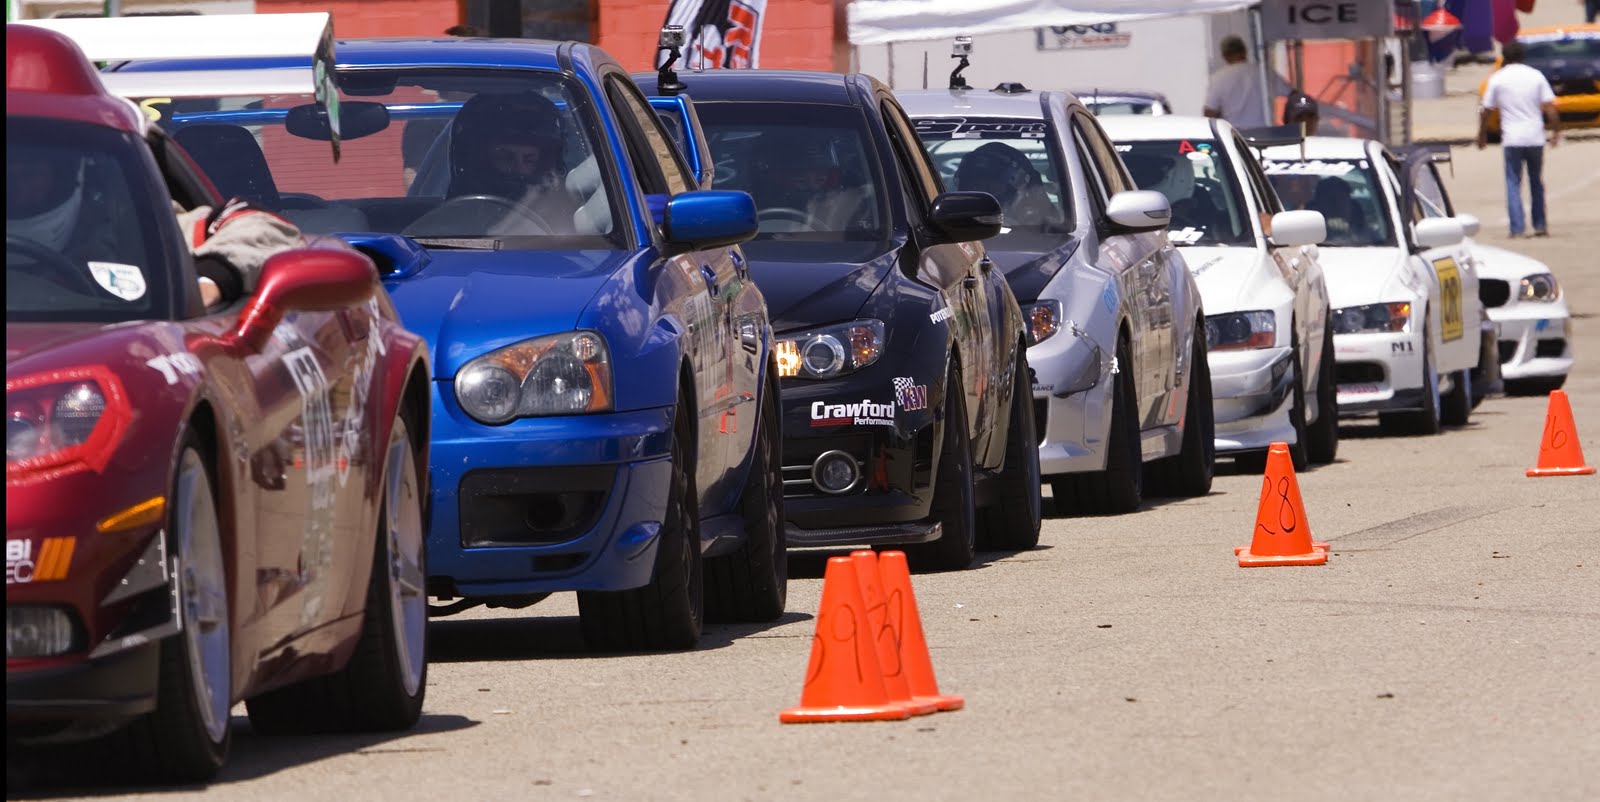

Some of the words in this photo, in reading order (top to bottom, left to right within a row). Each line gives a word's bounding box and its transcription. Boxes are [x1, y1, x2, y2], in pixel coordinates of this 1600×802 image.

[1287, 3, 1358, 25] ICE
[1178, 139, 1197, 154] A
[902, 384, 928, 412] KW
[811, 399, 895, 420] Crawford
[853, 416, 895, 427] Performance
[1258, 475, 1297, 535] 28
